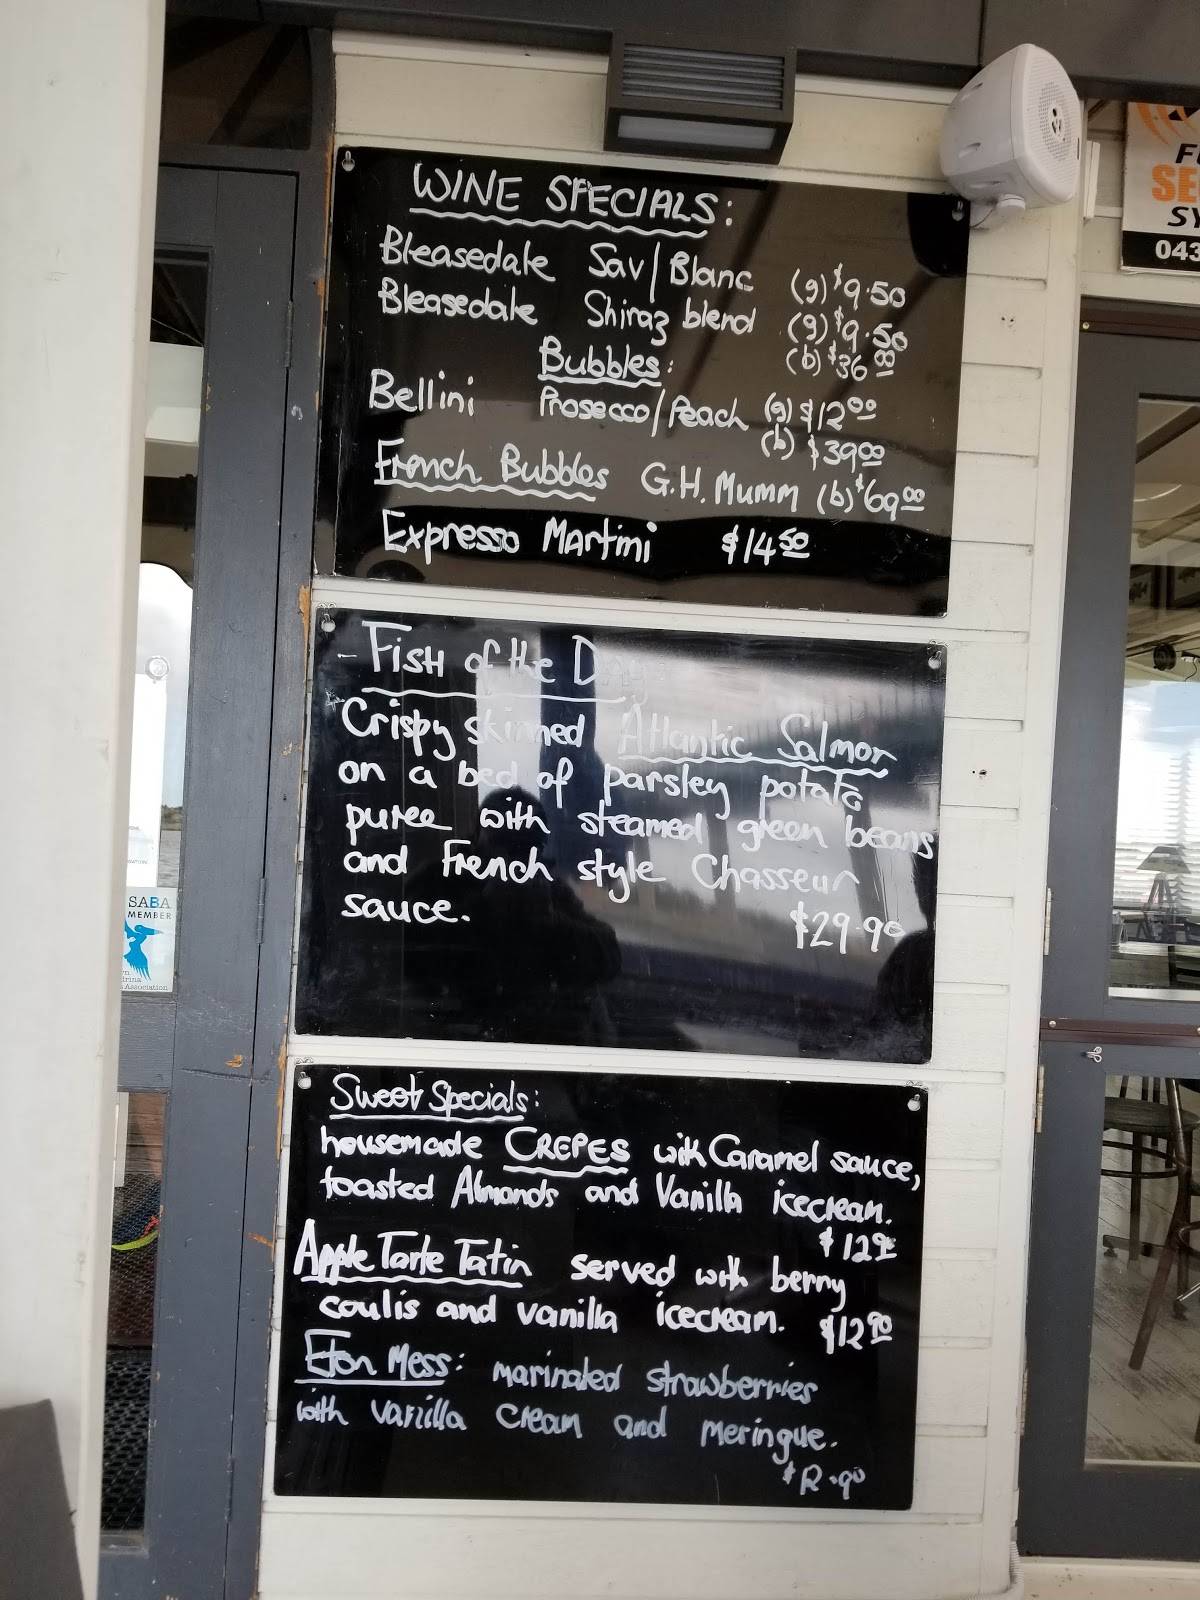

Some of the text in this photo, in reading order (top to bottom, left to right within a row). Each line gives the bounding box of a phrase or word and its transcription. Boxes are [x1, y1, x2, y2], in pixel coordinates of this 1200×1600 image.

[413, 162, 735, 227] WINE SPECIALS:
[379, 224, 556, 282] Bleasedale
[378, 277, 538, 326] Bleasedale
[584, 290, 669, 346] Shiraz
[683, 297, 756, 335] blend
[538, 337, 675, 380] Bubbles:
[369, 368, 475, 416] Bellini
[375, 438, 483, 485] French
[500, 442, 609, 490] Bubbles
[715, 470, 799, 513] Mumm
[382, 508, 520, 565] Expresso
[541, 516, 658, 564] Martini
[464, 638, 501, 675] of
[341, 697, 457, 762] Crispy
[464, 708, 586, 748] skinned
[618, 703, 752, 758] Atlantic
[338, 760, 386, 787] on
[407, 765, 438, 789] a
[458, 760, 519, 789] bed
[536, 757, 575, 808] of
[603, 763, 731, 820] parsley
[345, 797, 935, 860] puree with steamed green beans
[343, 838, 861, 904] and French style Chasseur
[127, 910, 172, 920] MEMBER
[128, 895, 170, 908] SABA
[341, 892, 472, 925] sauce.
[330, 1072, 541, 1121] Sweet Specials:
[320, 1124, 484, 1160] housemade
[504, 1126, 632, 1164] CREPES
[708, 1133, 820, 1174] Caramel
[830, 1151, 921, 1191] sauce,
[319, 1165, 435, 1202] toasted
[450, 1164, 560, 1209] Almonds
[584, 1176, 640, 1207] and
[293, 1218, 376, 1286] Apple
[453, 1237, 533, 1277] Tatin
[570, 1253, 677, 1289] served
[694, 1254, 749, 1292] with
[770, 1255, 847, 1313] berry
[318, 1288, 421, 1321] coulis
[436, 1294, 497, 1325] and
[517, 1295, 619, 1334] vanilla
[388, 1343, 466, 1381] Mess:
[645, 1360, 819, 1405] strawberries
[613, 1405, 668, 1440] and
